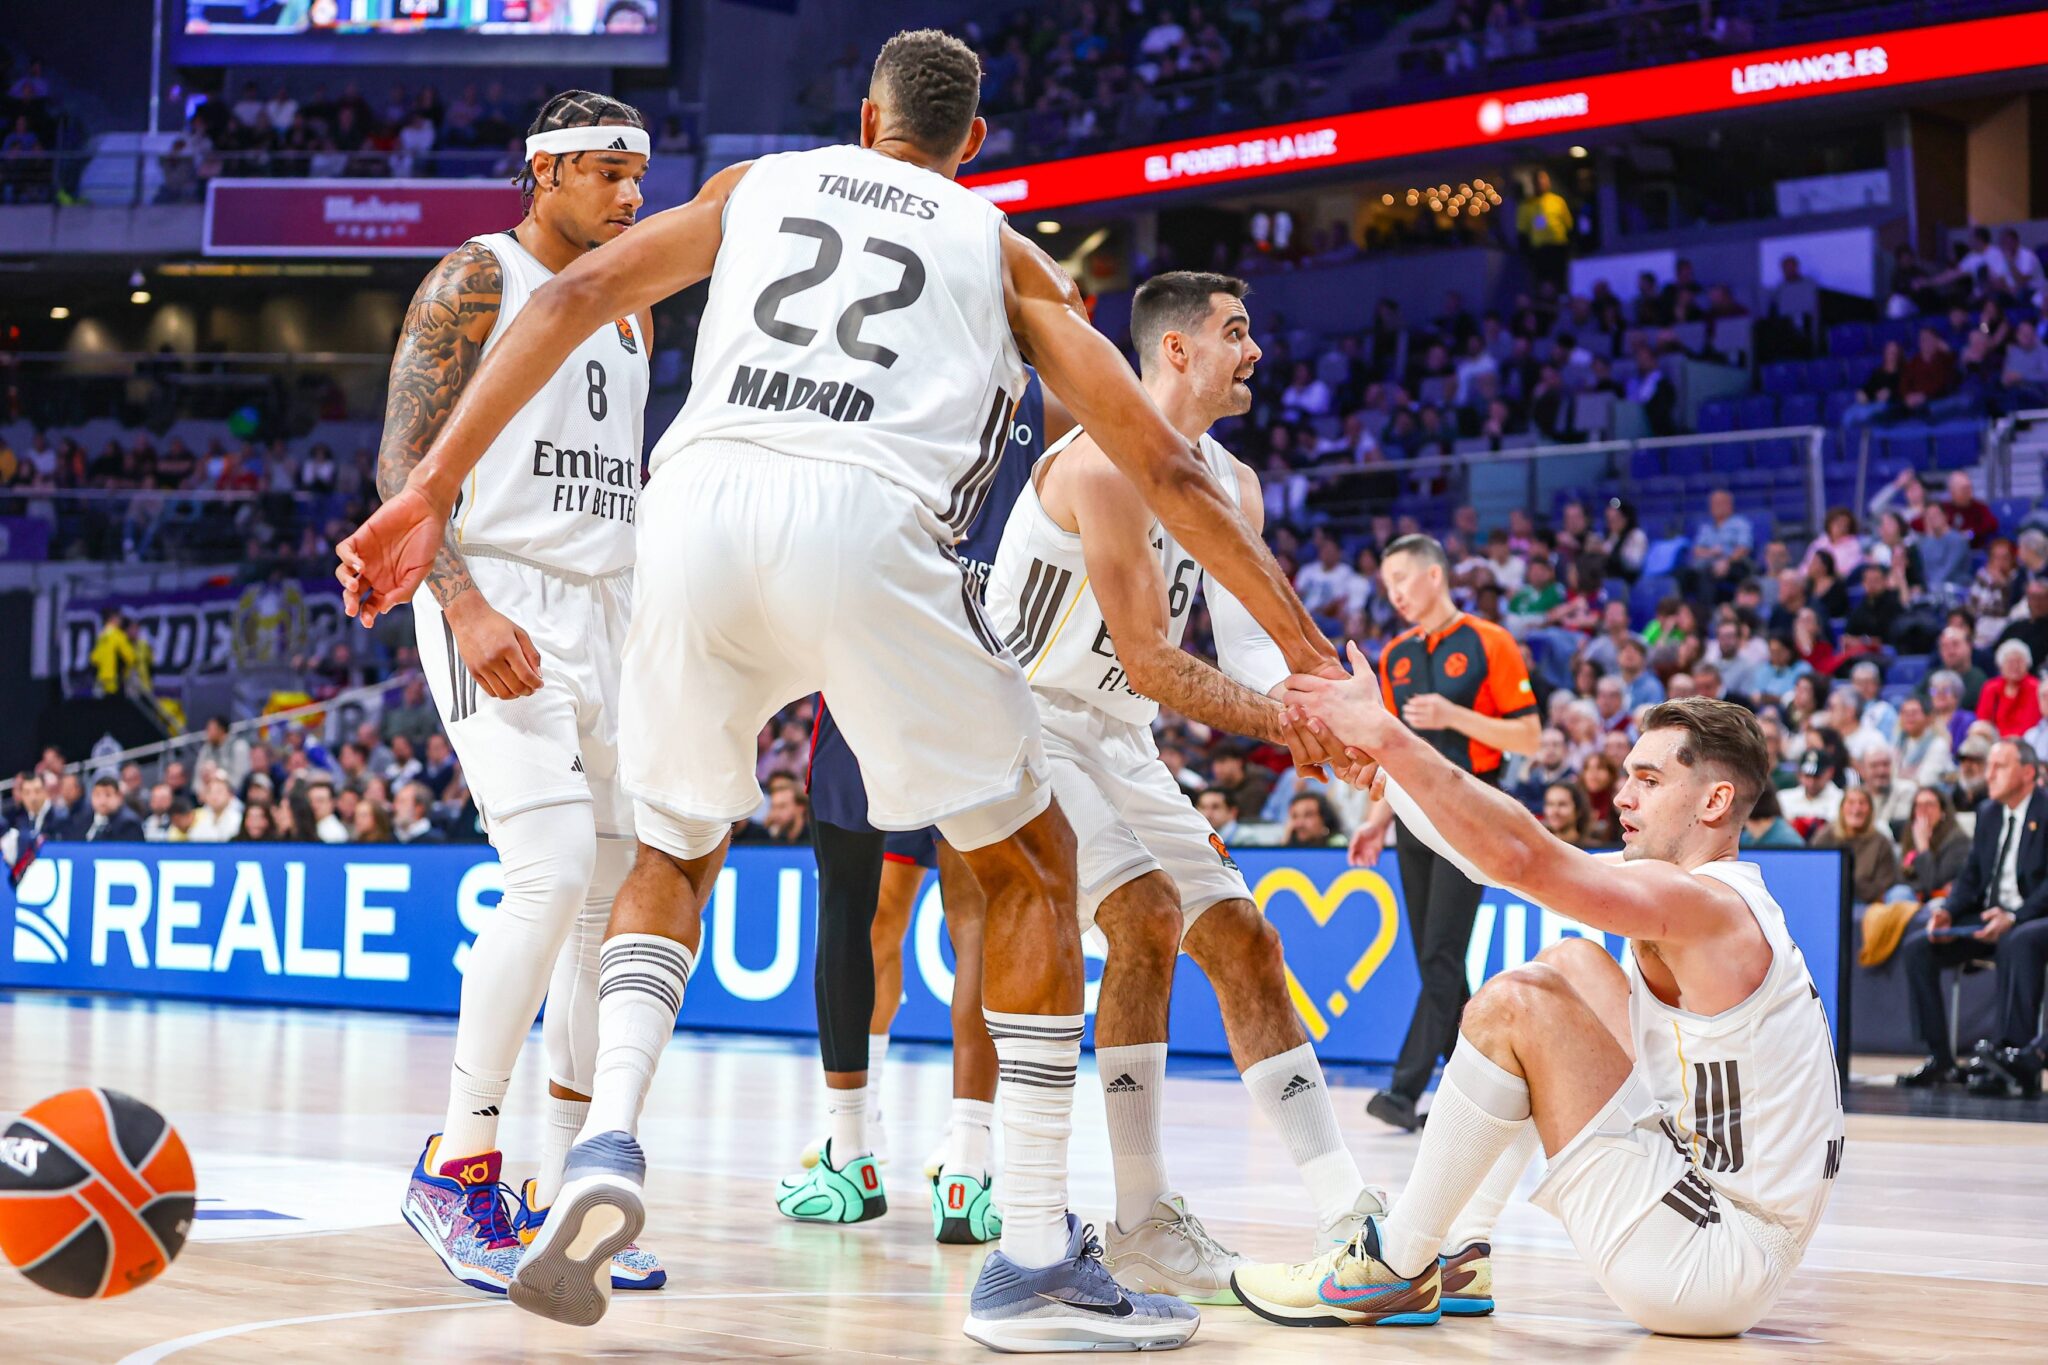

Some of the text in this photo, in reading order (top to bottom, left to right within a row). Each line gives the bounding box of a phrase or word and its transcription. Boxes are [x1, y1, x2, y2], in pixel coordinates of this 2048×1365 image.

[1731, 46, 1888, 94] LEDVANCE.ES
[1266, 135, 1296, 164] LA
[818, 174, 940, 220] TAVARES
[753, 216, 926, 370] 22
[586, 359, 608, 422] 8
[727, 364, 875, 422] MADRID
[533, 440, 636, 491] Emirat
[553, 484, 589, 512] FLY
[1168, 559, 1195, 618] 6
[91, 859, 411, 981] REALE
